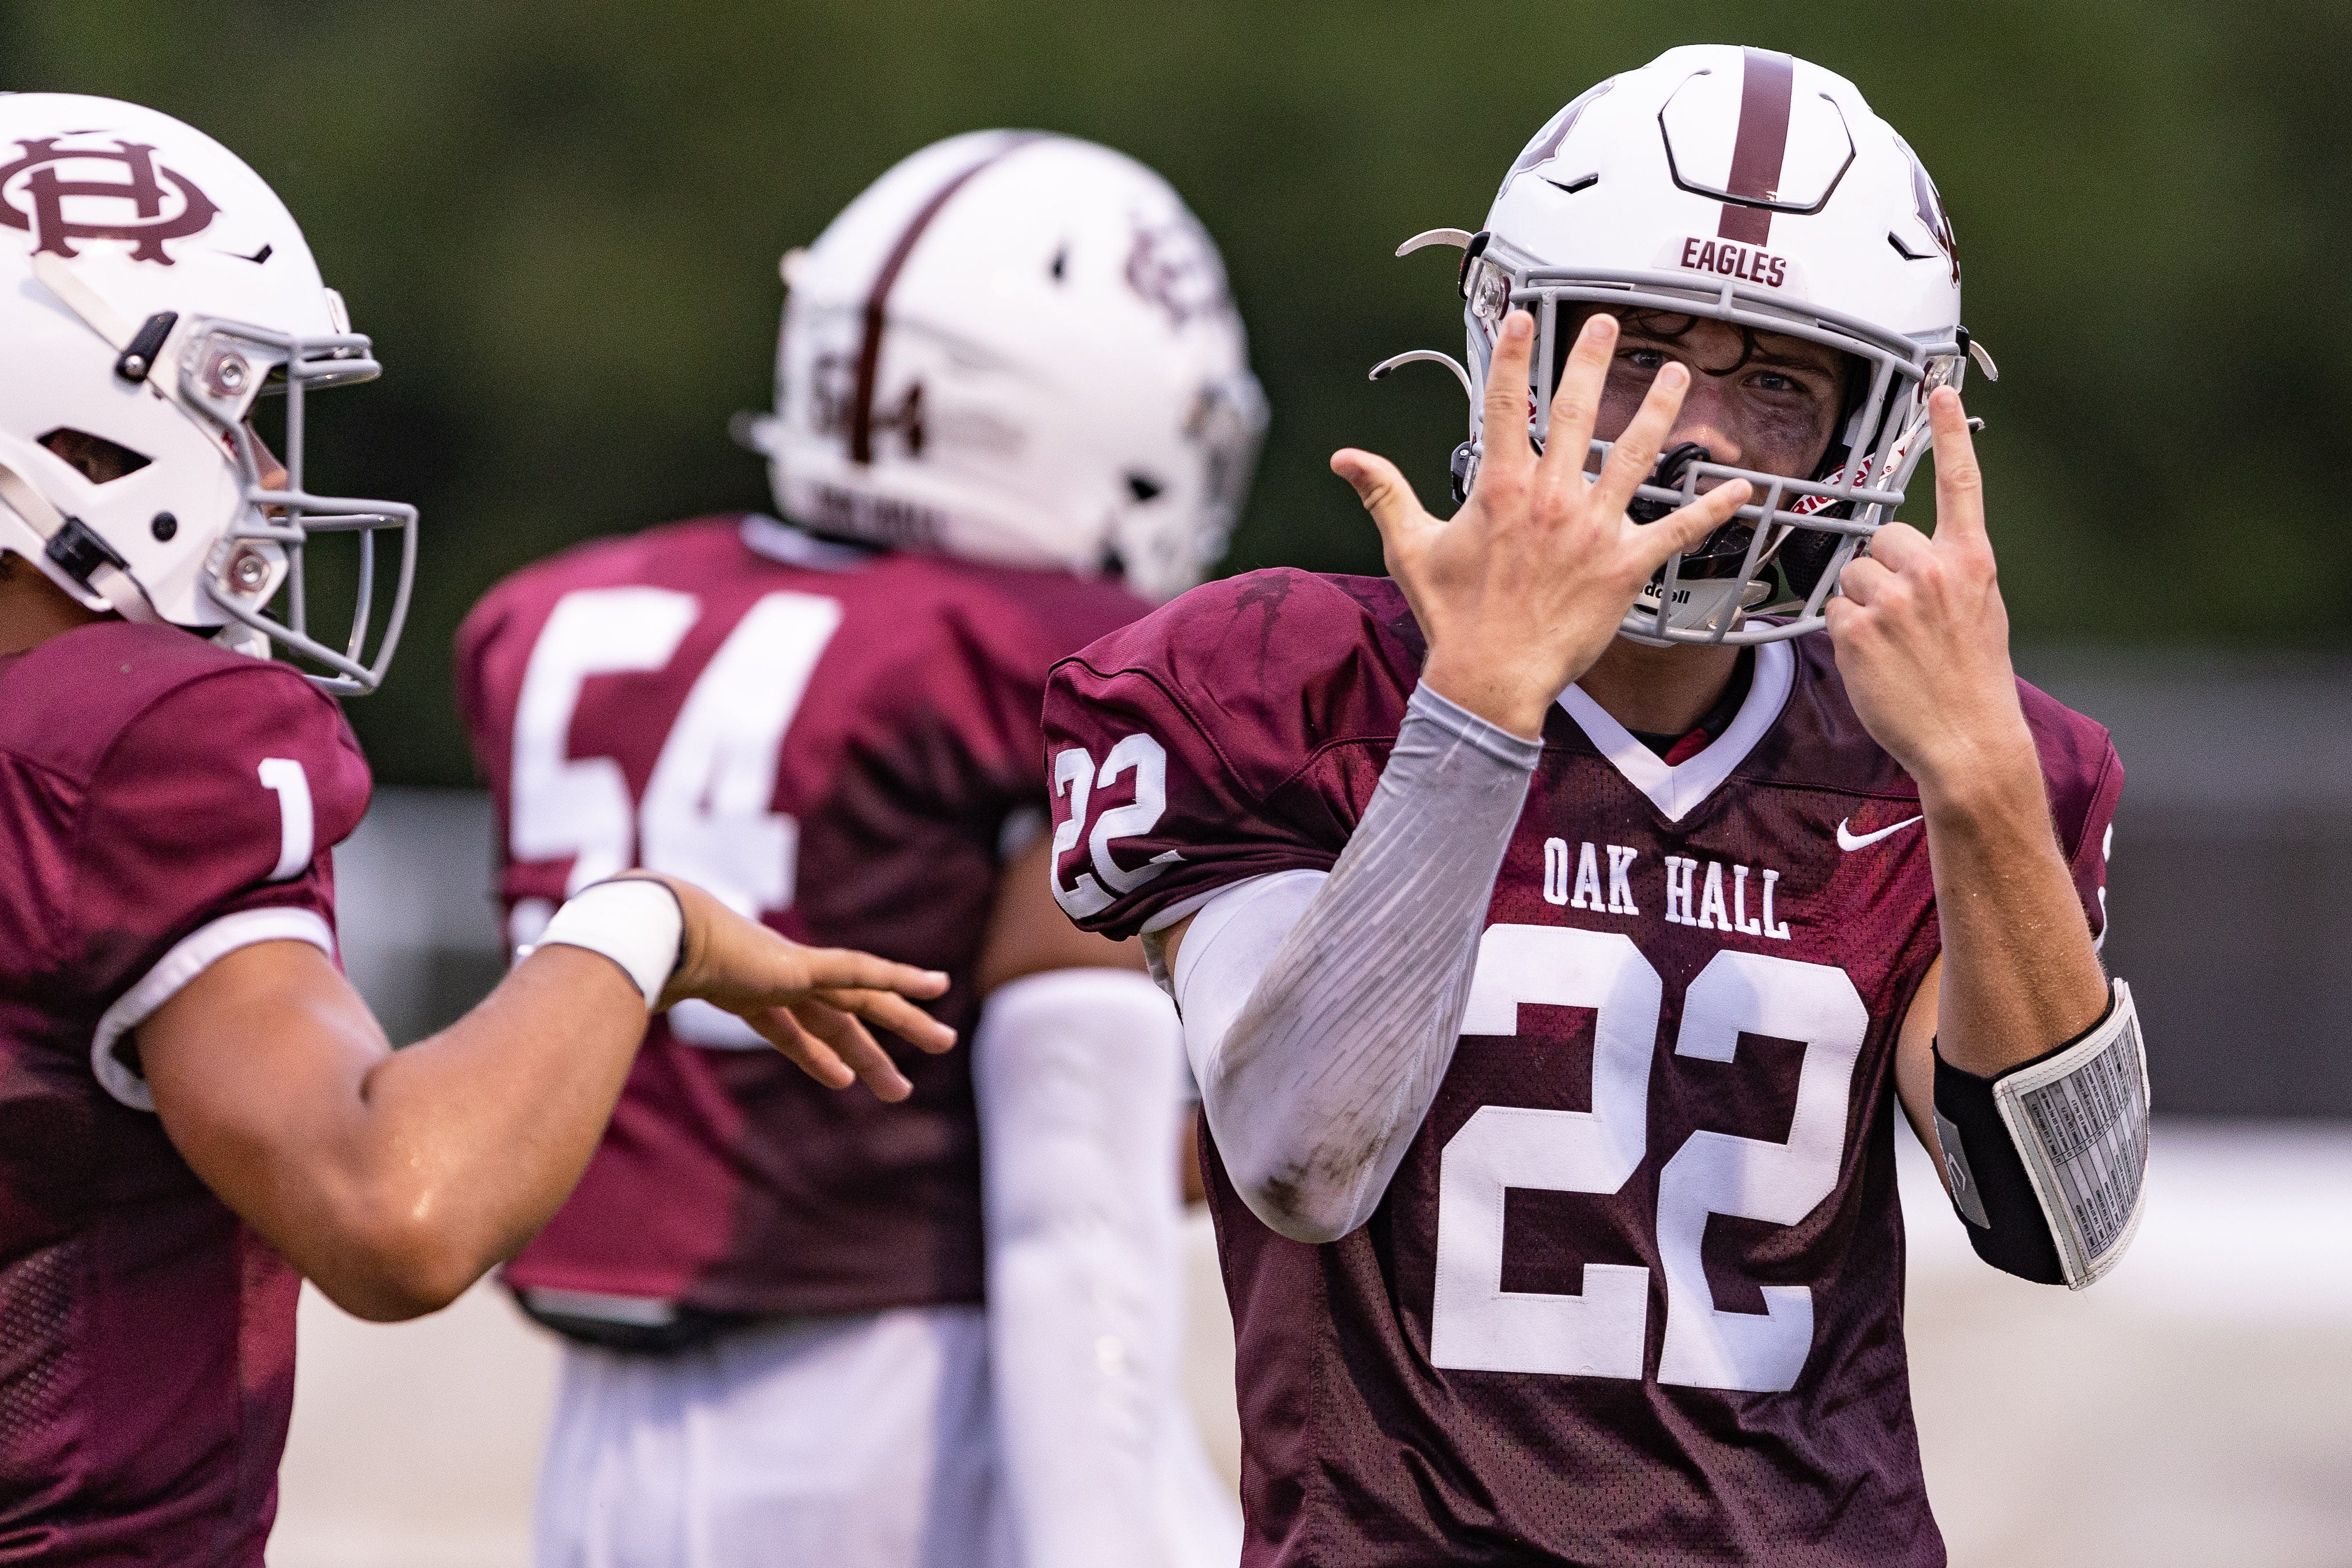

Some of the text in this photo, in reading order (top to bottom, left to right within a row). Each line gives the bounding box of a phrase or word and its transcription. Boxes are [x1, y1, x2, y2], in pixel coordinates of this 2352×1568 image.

[1680, 237, 1786, 288] EAGLES
[257, 757, 315, 882] 1
[510, 587, 845, 1050] 54
[1050, 732, 1187, 921] 22
[1542, 837, 1792, 940] OAK HALL
[1430, 923, 1869, 1393] 22
